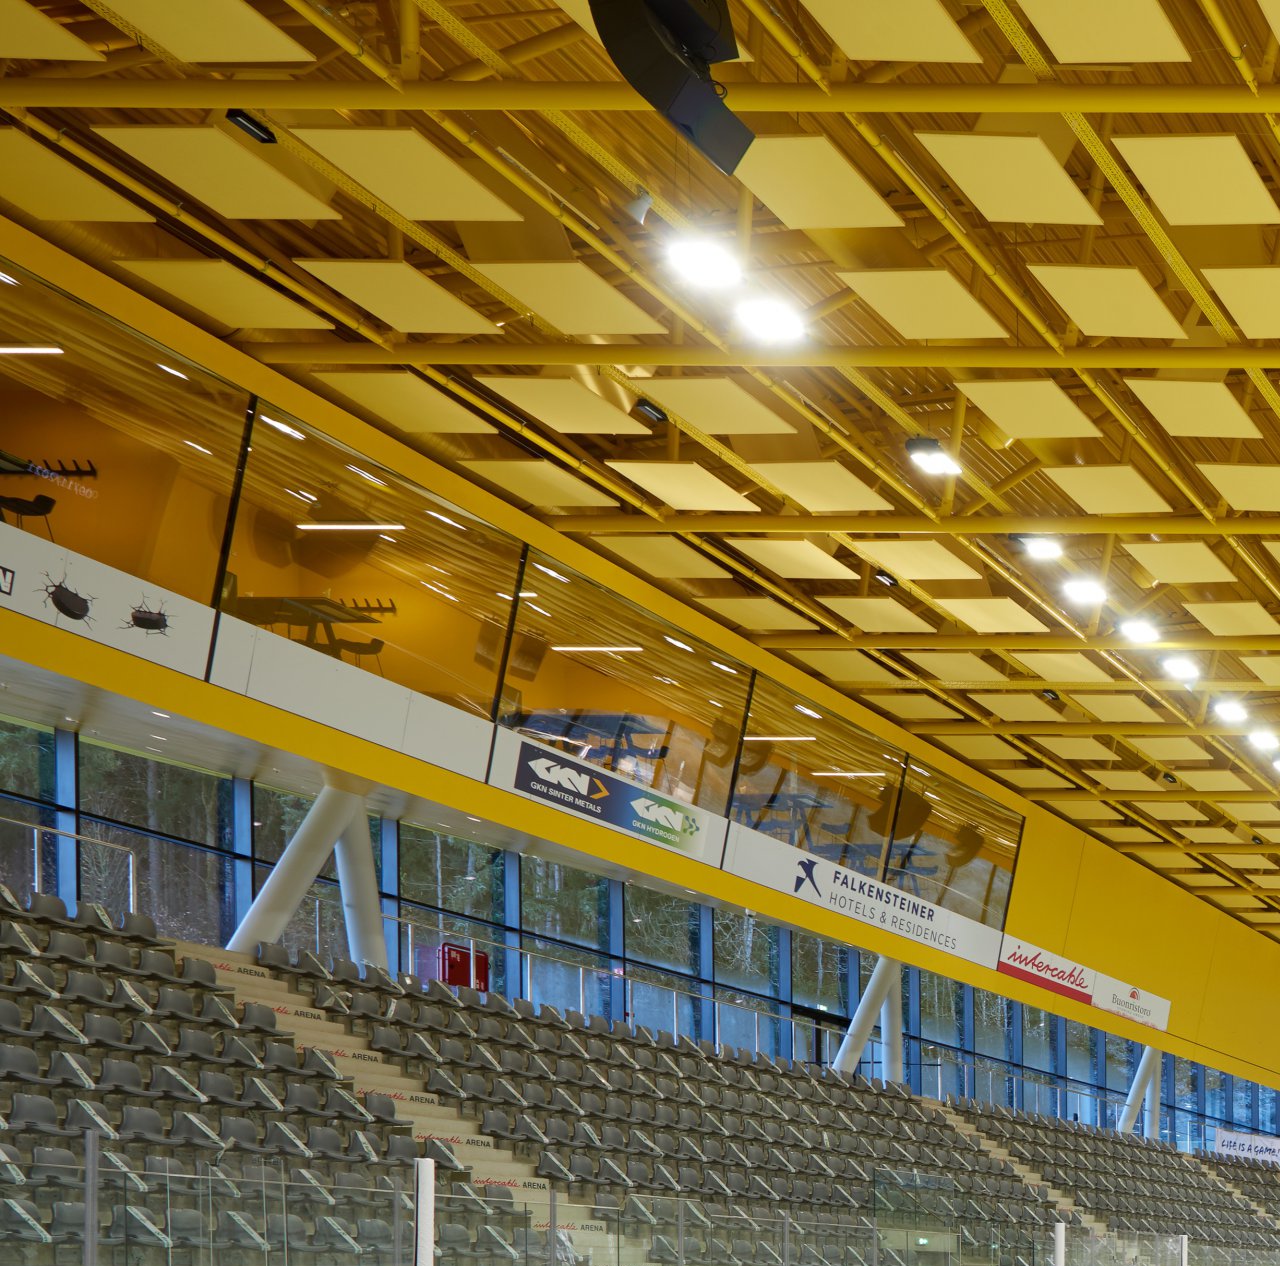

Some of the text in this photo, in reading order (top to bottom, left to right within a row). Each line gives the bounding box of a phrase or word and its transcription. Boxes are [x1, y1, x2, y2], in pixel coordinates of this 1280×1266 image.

[530, 781, 602, 813] GKN SINTER METALS
[632, 820, 680, 843] GKN HYDROGEN
[833, 870, 934, 921] FALKENSTEINER
[829, 892, 957, 950] HOTELS & RESIDENCES
[237, 967, 266, 979] ARENA
[1007, 945, 1088, 989] intercable
[1112, 994, 1151, 1017] Buonristoro
[294, 1009, 322, 1021] ARENA
[352, 1051, 379, 1064] ARENA
[409, 1094, 435, 1105] ARENA
[465, 1138, 491, 1148] ARENA
[522, 1181, 547, 1191] ARENA
[580, 1224, 604, 1232] ARENA
